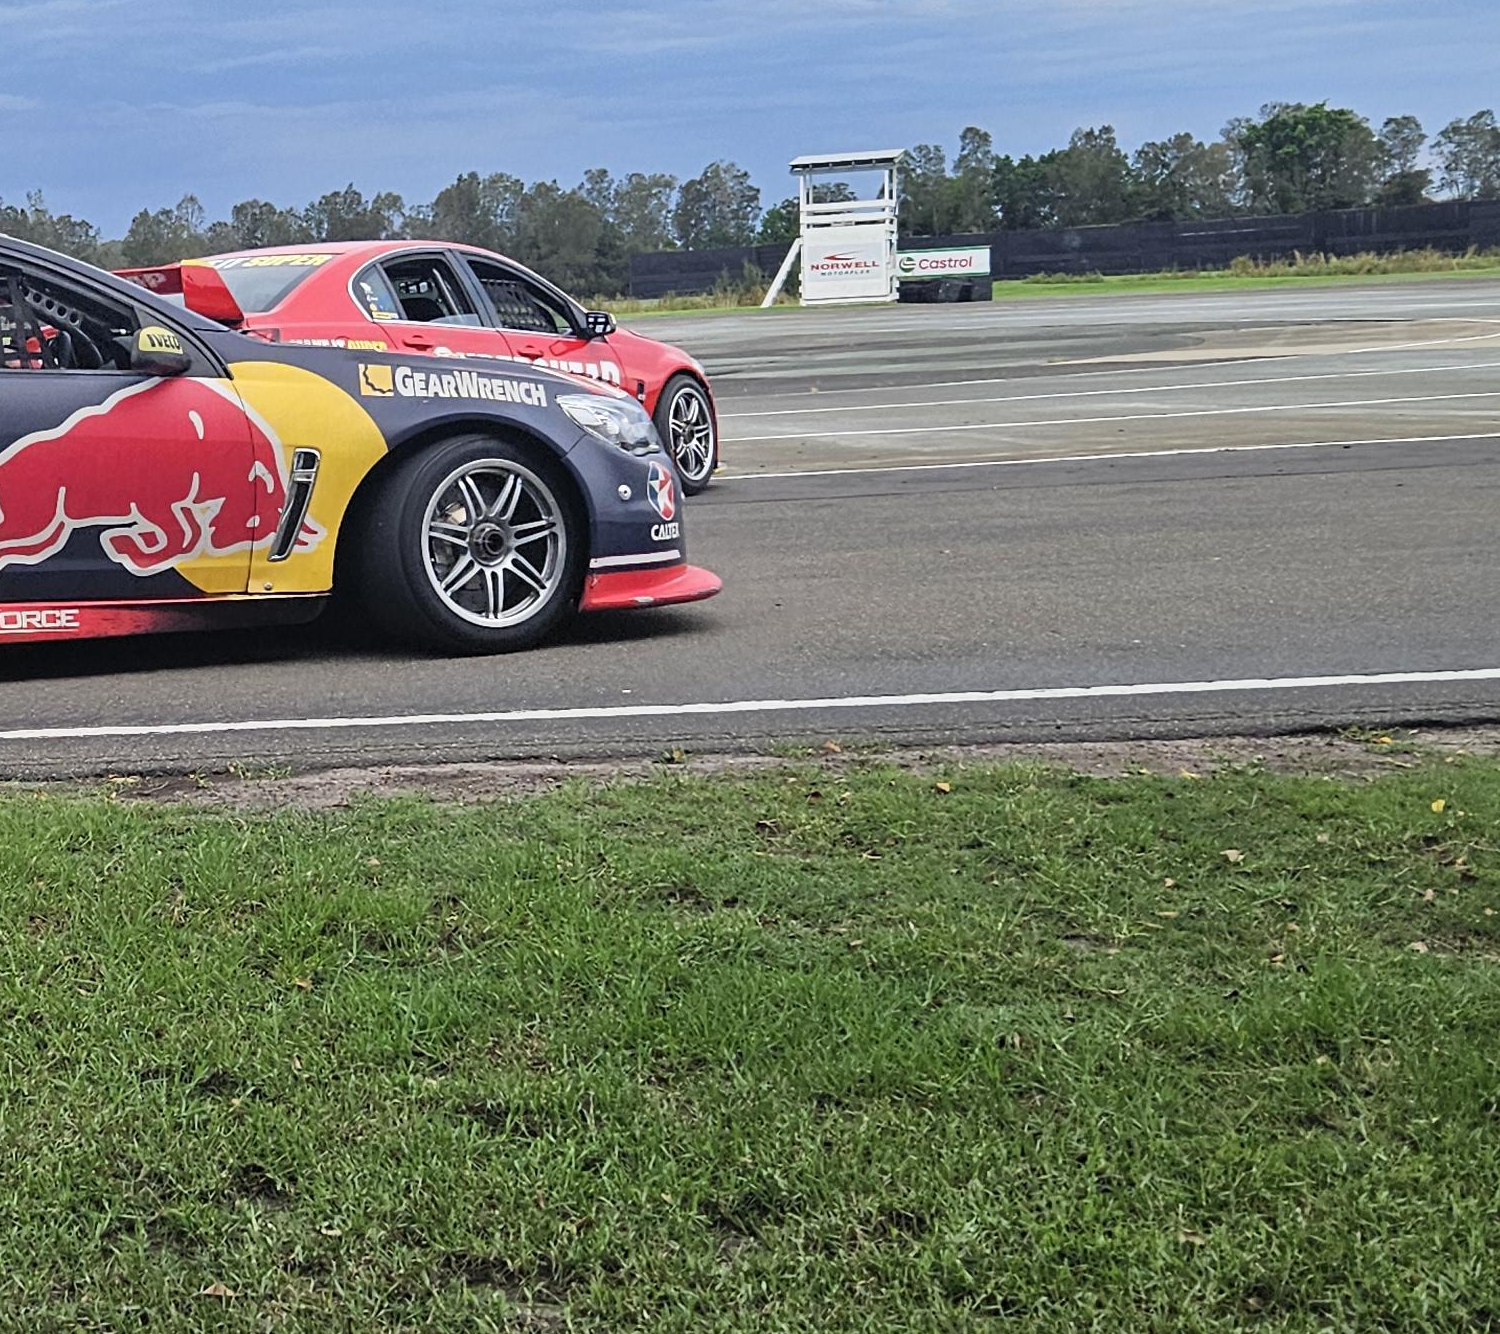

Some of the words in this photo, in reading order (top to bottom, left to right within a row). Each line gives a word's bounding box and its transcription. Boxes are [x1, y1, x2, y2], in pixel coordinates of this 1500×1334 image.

[242, 254, 333, 267] SUPER
[810, 259, 880, 271] NORWELL
[918, 255, 973, 271] Castrol
